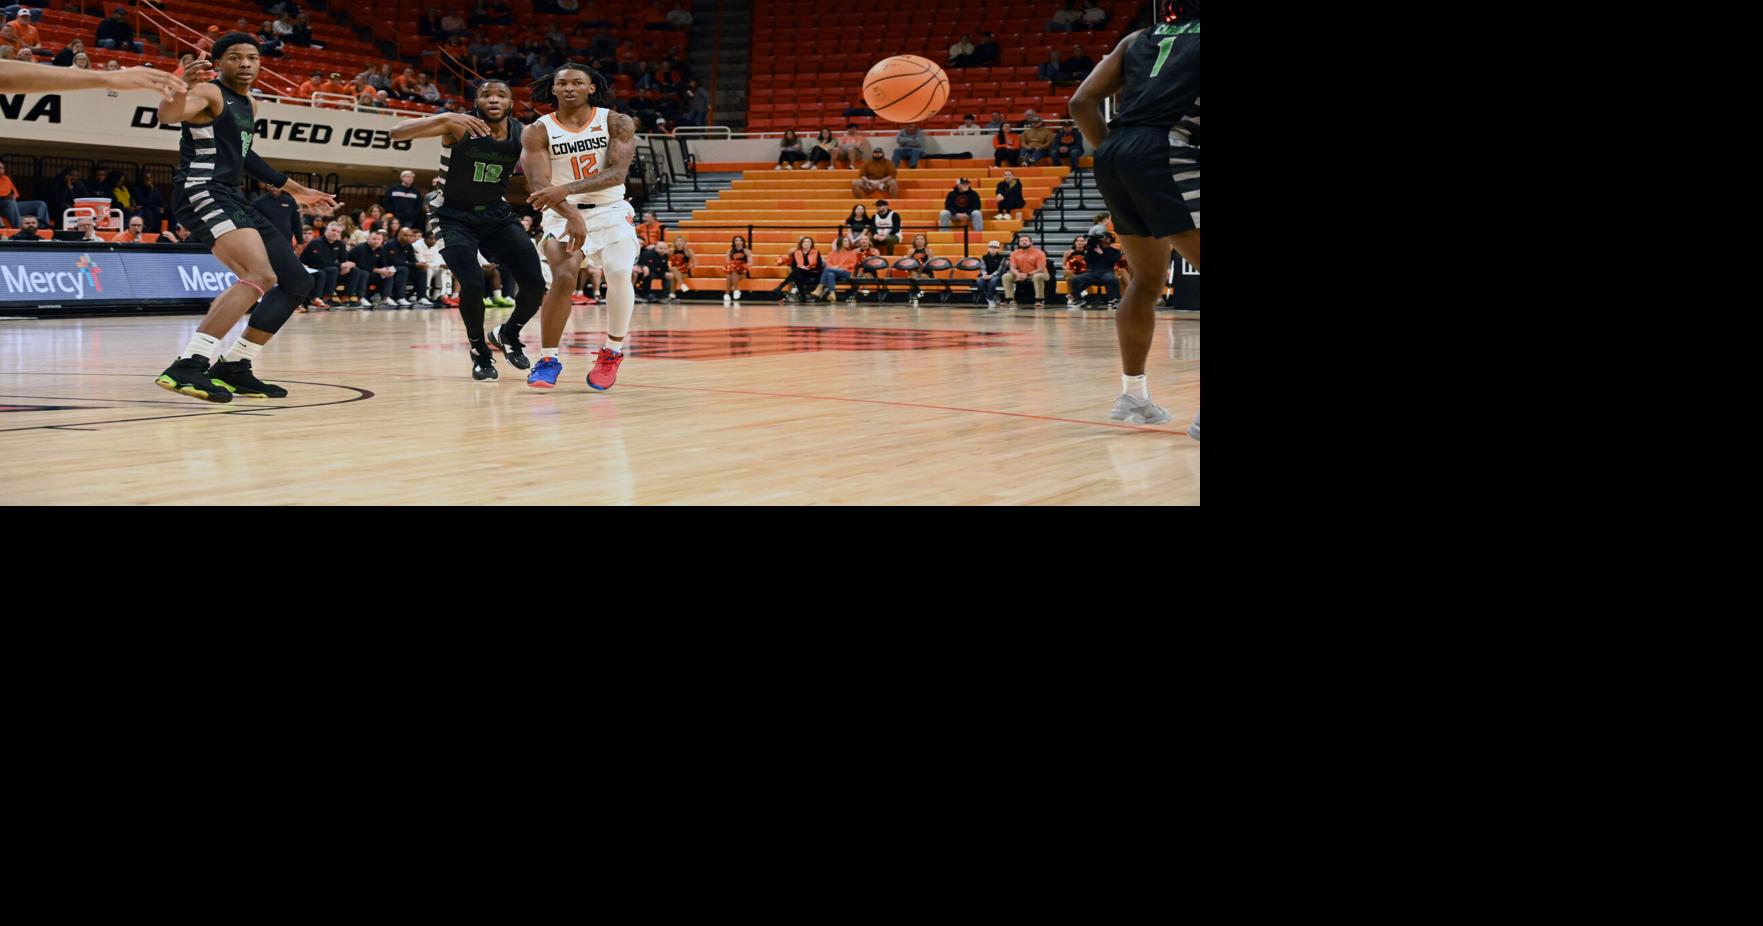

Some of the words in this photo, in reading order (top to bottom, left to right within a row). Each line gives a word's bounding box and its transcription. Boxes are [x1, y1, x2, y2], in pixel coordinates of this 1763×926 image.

[1149, 36, 1177, 78] 1
[551, 136, 608, 156] COWBOYS
[473, 161, 504, 183] 12
[570, 153, 599, 181] 12
[0, 264, 84, 299] Mercy
[177, 265, 240, 292] Merc
